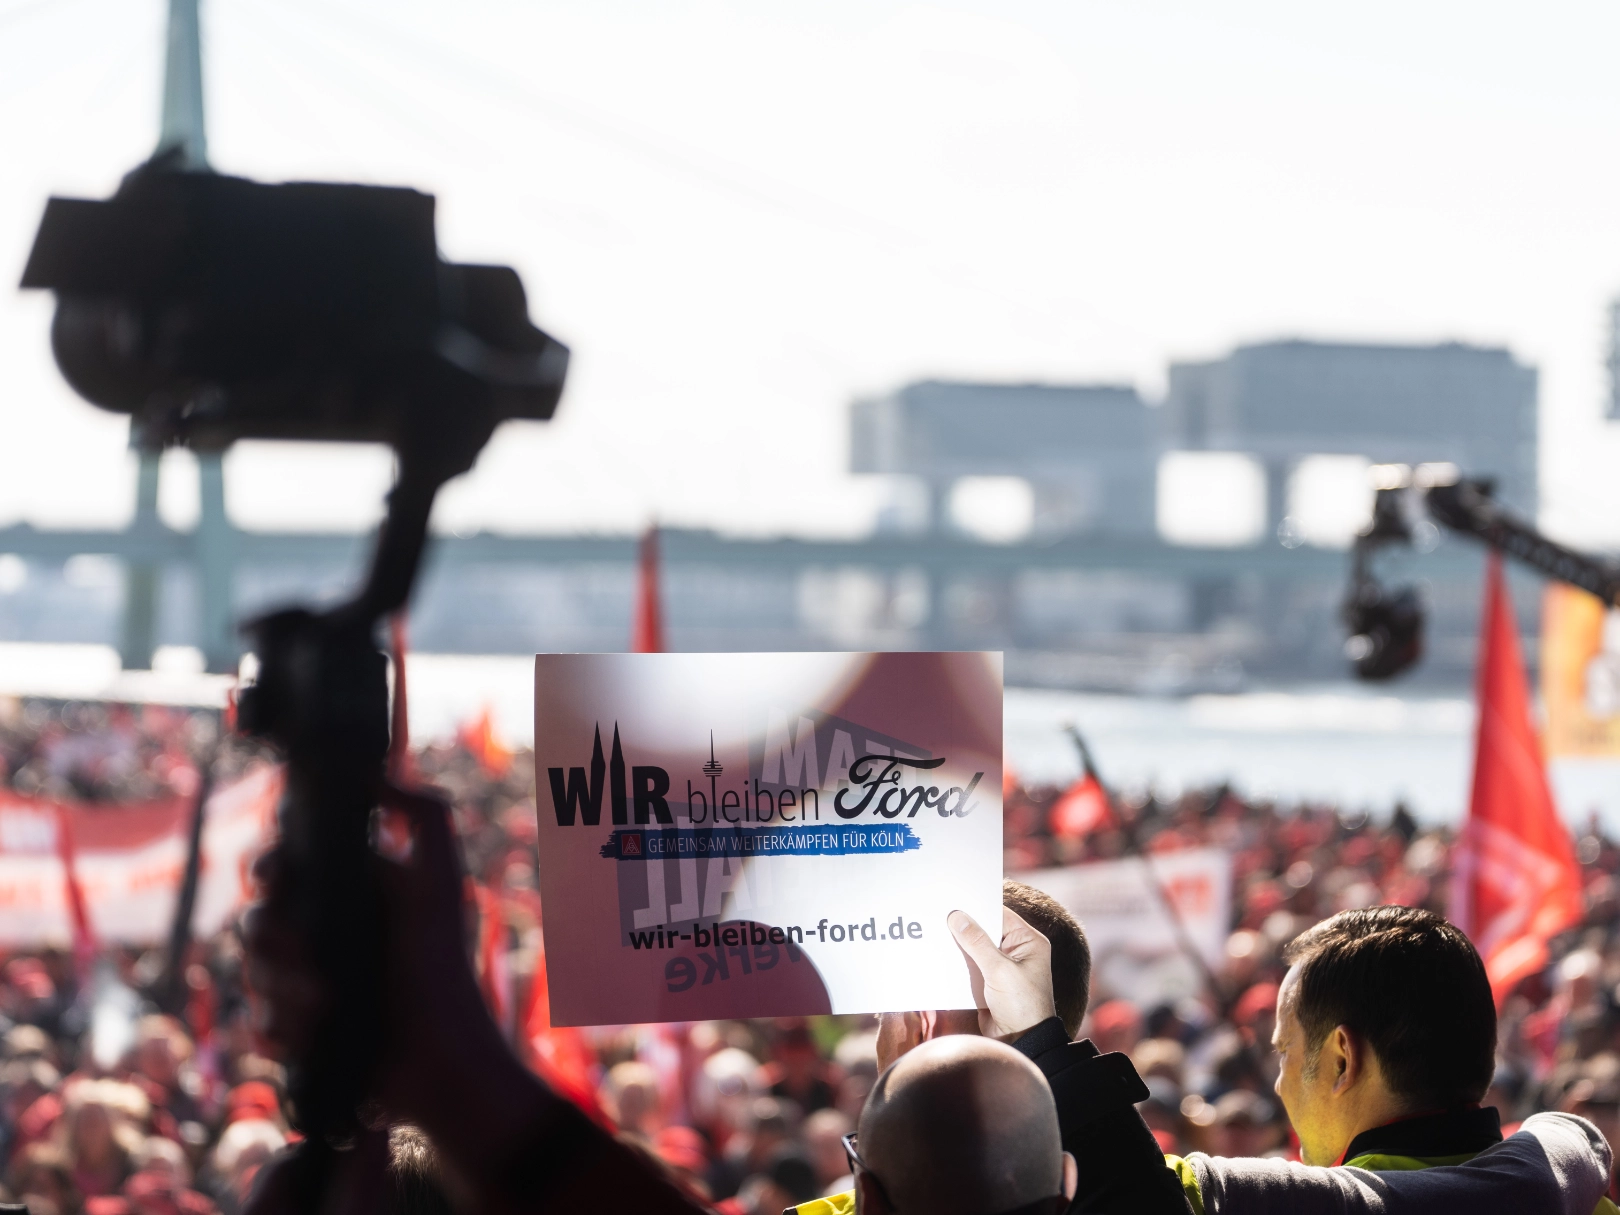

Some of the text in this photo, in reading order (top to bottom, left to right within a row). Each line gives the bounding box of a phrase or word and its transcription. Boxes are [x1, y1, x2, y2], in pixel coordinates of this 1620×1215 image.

[548, 720, 985, 826] WIR bleiben Ford
[648, 830, 904, 853] GEMEINSAM WEITERKÄMPFEN FÜR KÖLN
[628, 915, 924, 950] wir-bleiben-ford.de
